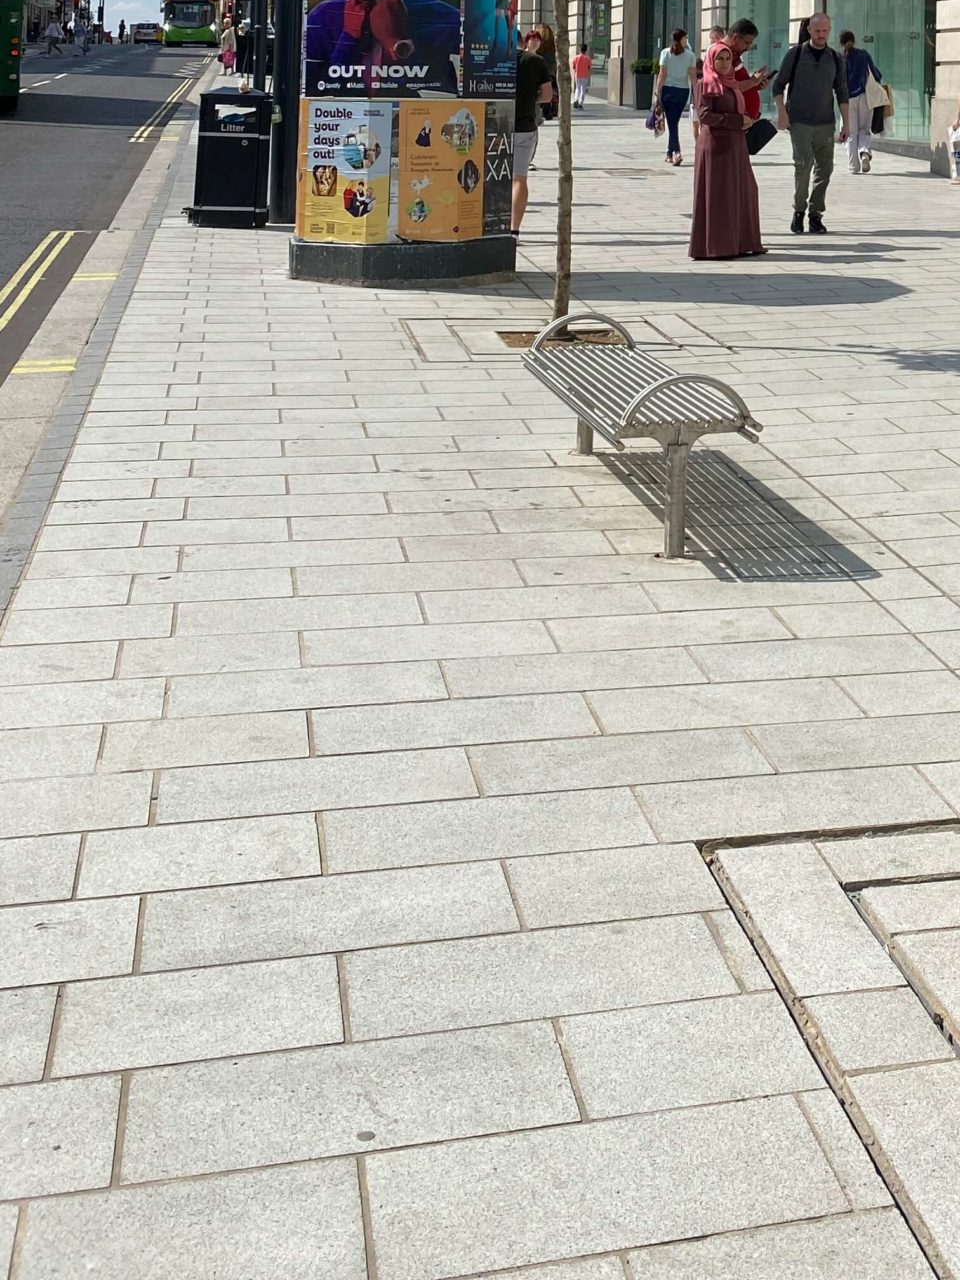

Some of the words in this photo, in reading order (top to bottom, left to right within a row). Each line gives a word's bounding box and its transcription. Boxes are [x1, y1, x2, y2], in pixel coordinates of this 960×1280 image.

[328, 65, 366, 78] OUT
[371, 65, 429, 78] NOW
[314, 107, 353, 119] Double
[221, 123, 246, 132] Litter
[314, 122, 341, 133] your
[313, 135, 341, 147] days
[312, 150, 335, 160] out!
